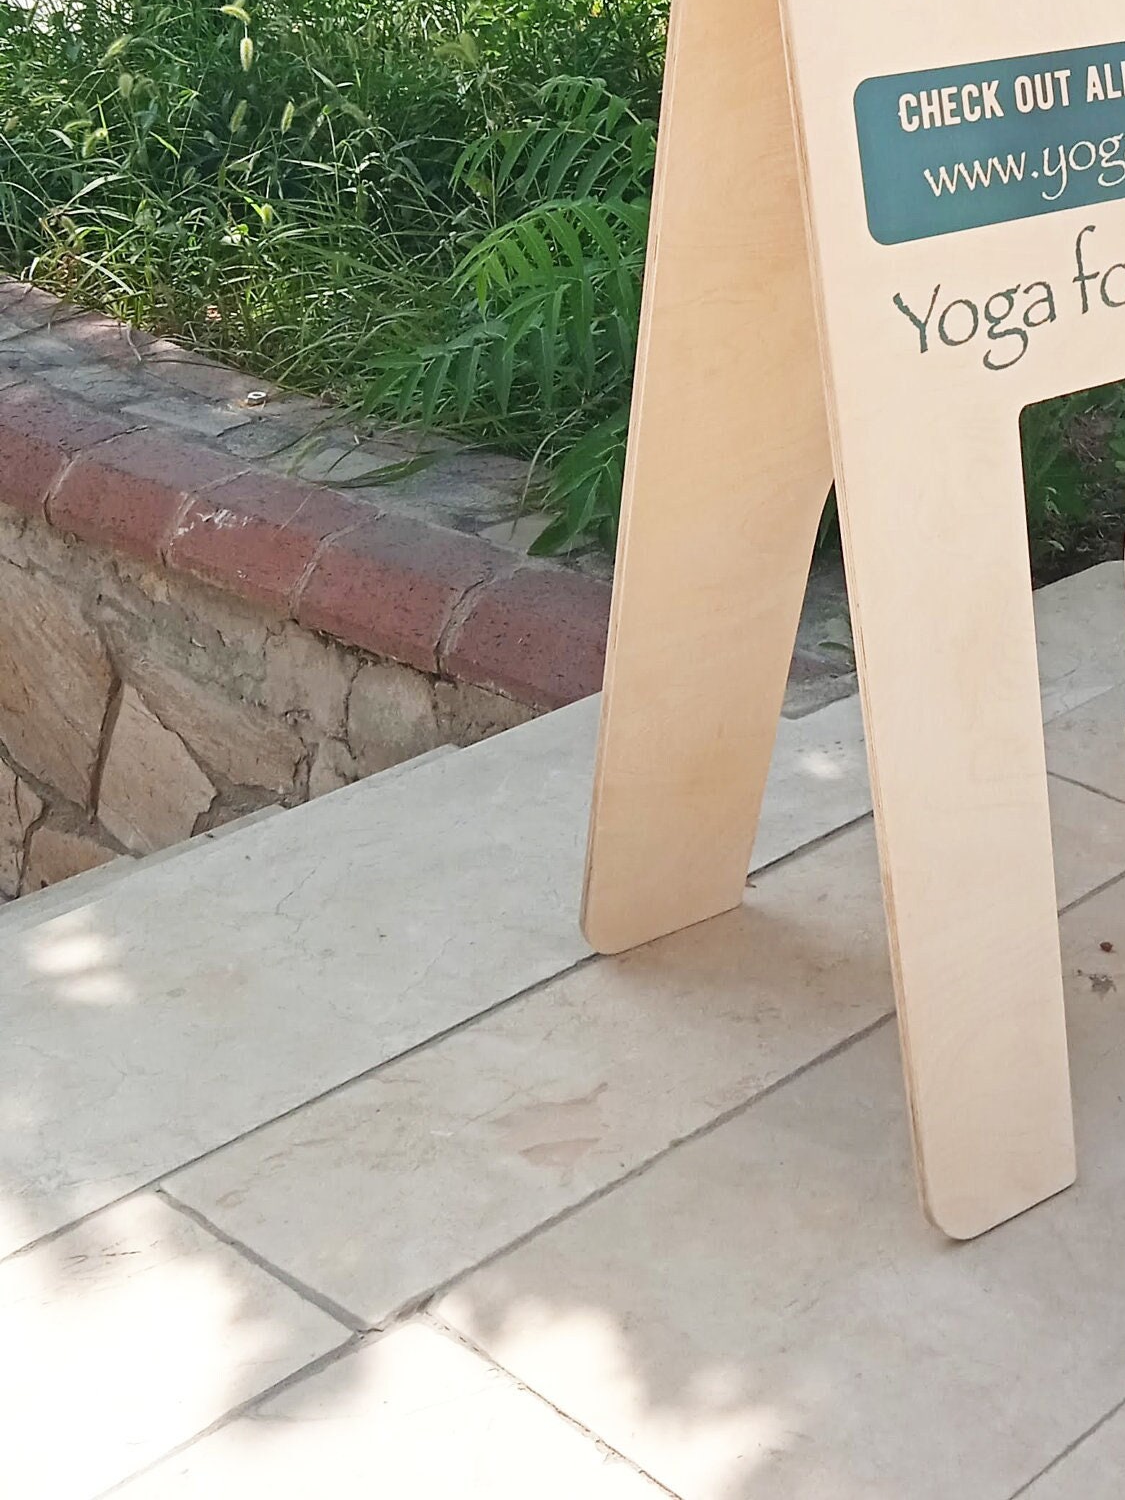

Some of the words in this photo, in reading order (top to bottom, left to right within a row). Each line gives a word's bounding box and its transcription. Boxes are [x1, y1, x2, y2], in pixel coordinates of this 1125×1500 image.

[898, 78, 1003, 133] CHECK
[1014, 70, 1070, 110] OUT
[892, 277, 1057, 370] Yoga
